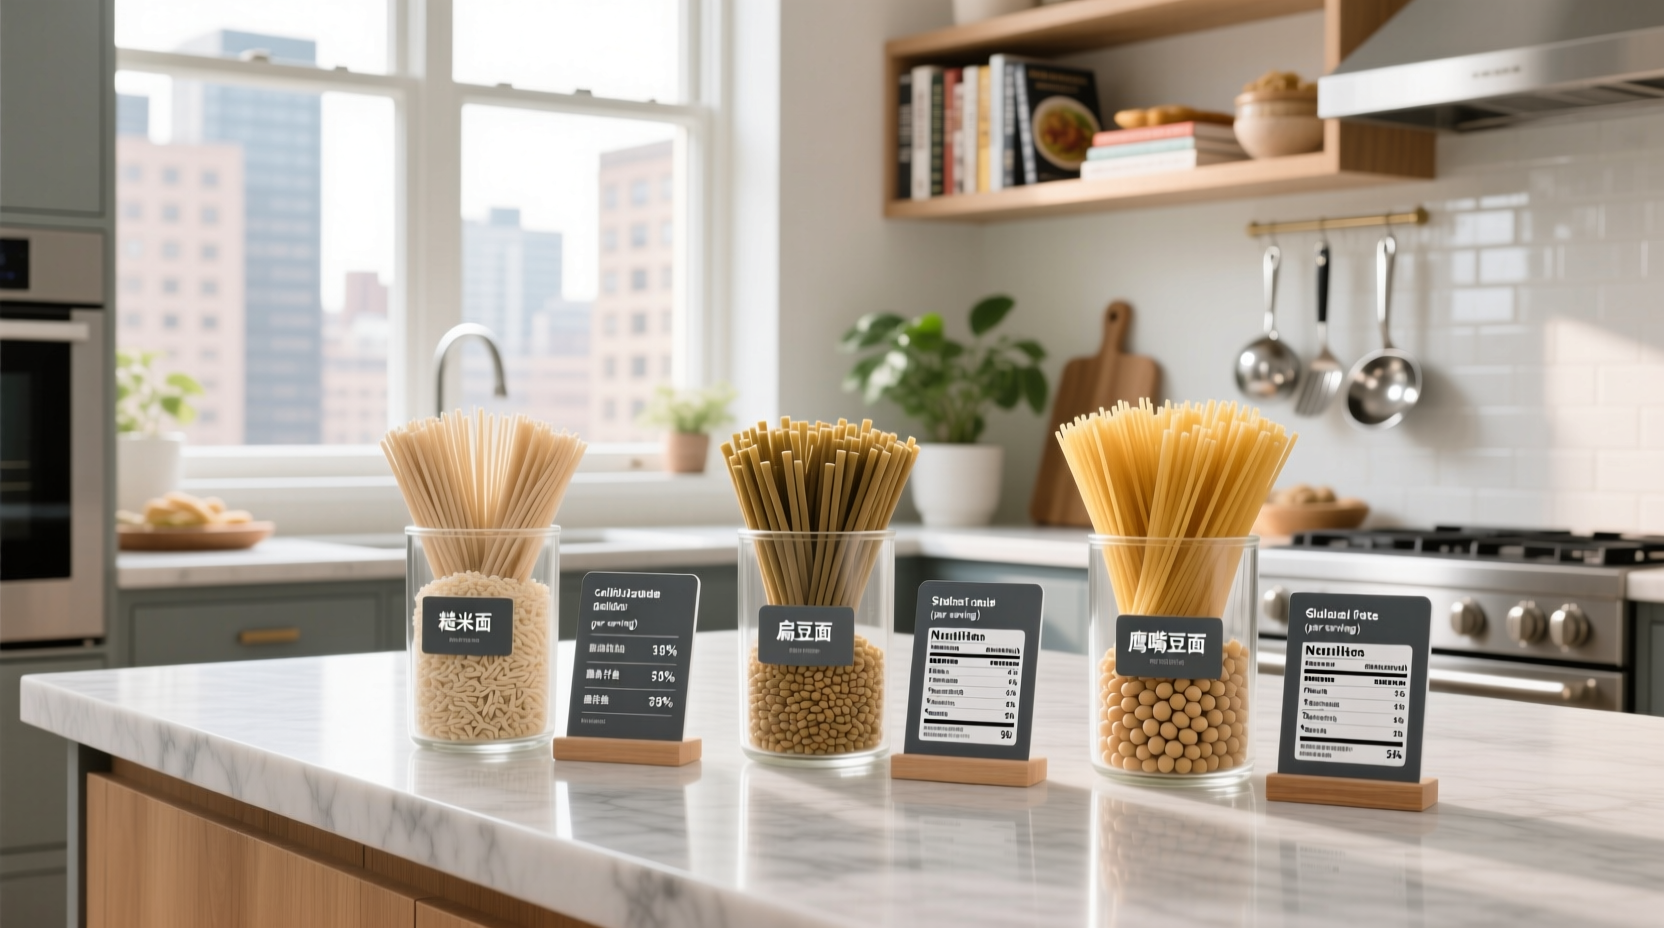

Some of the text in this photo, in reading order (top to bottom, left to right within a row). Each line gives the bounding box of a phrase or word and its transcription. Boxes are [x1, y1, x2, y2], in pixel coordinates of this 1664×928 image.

[438, 610, 493, 633] 糙米面
[776, 619, 833, 643] 扁豆面
[1128, 630, 1207, 655] 鹰嘴豆面
